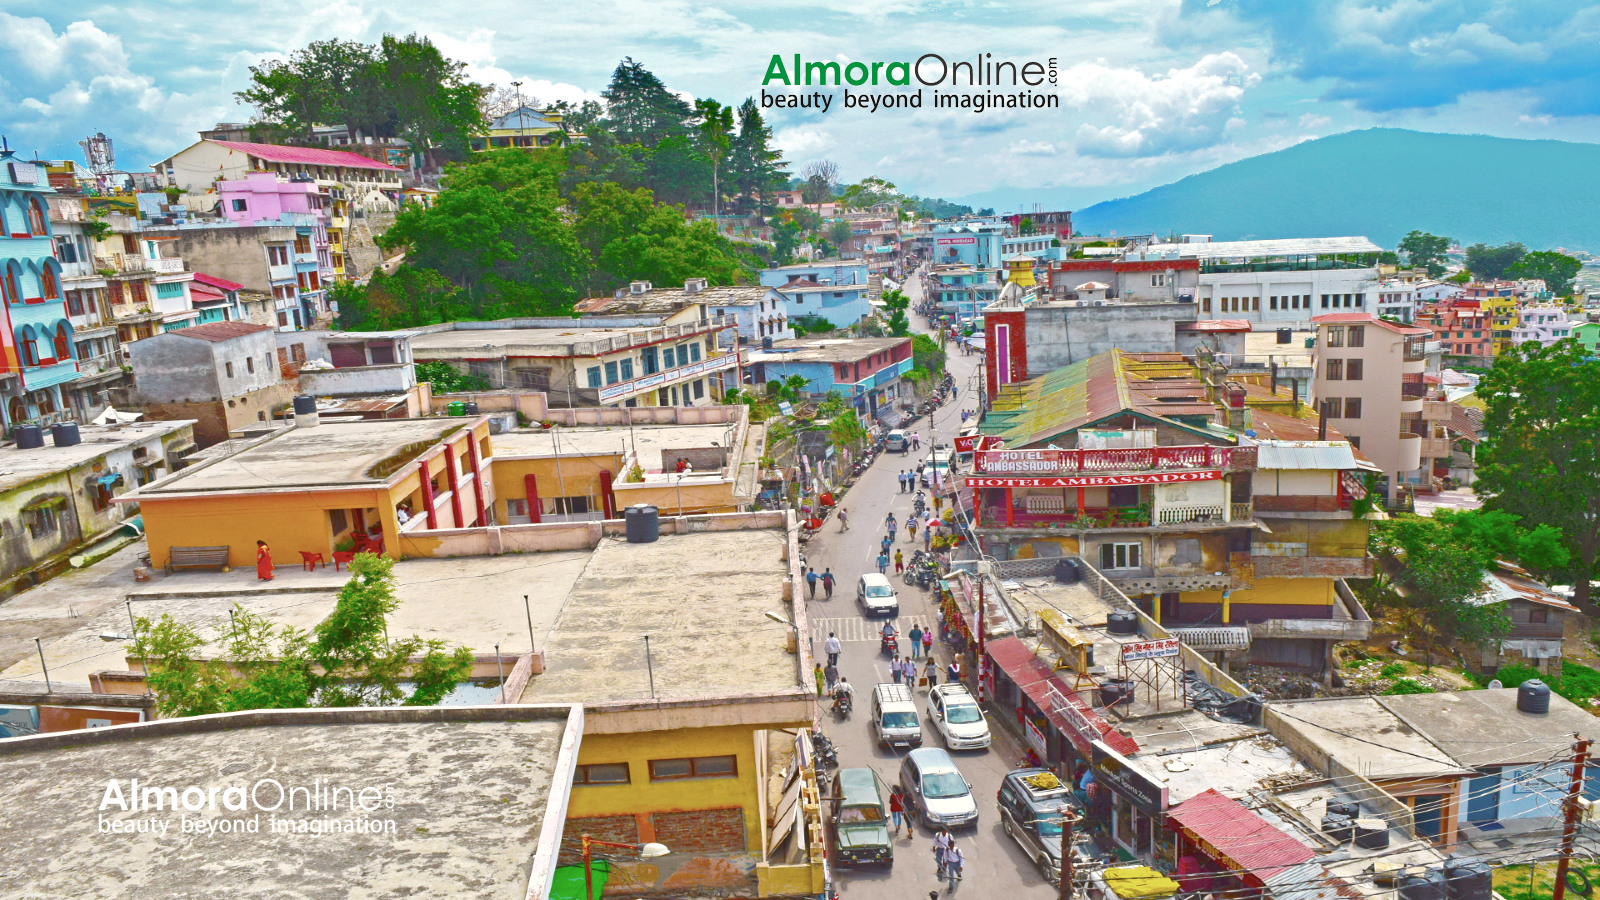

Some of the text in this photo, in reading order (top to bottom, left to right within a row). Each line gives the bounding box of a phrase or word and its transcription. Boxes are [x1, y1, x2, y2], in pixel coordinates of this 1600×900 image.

[1000, 452, 1045, 460] HOTEL
[987, 460, 1058, 472] AMBASSADOR
[968, 472, 1213, 487] HOTEL AMBASSADOR
